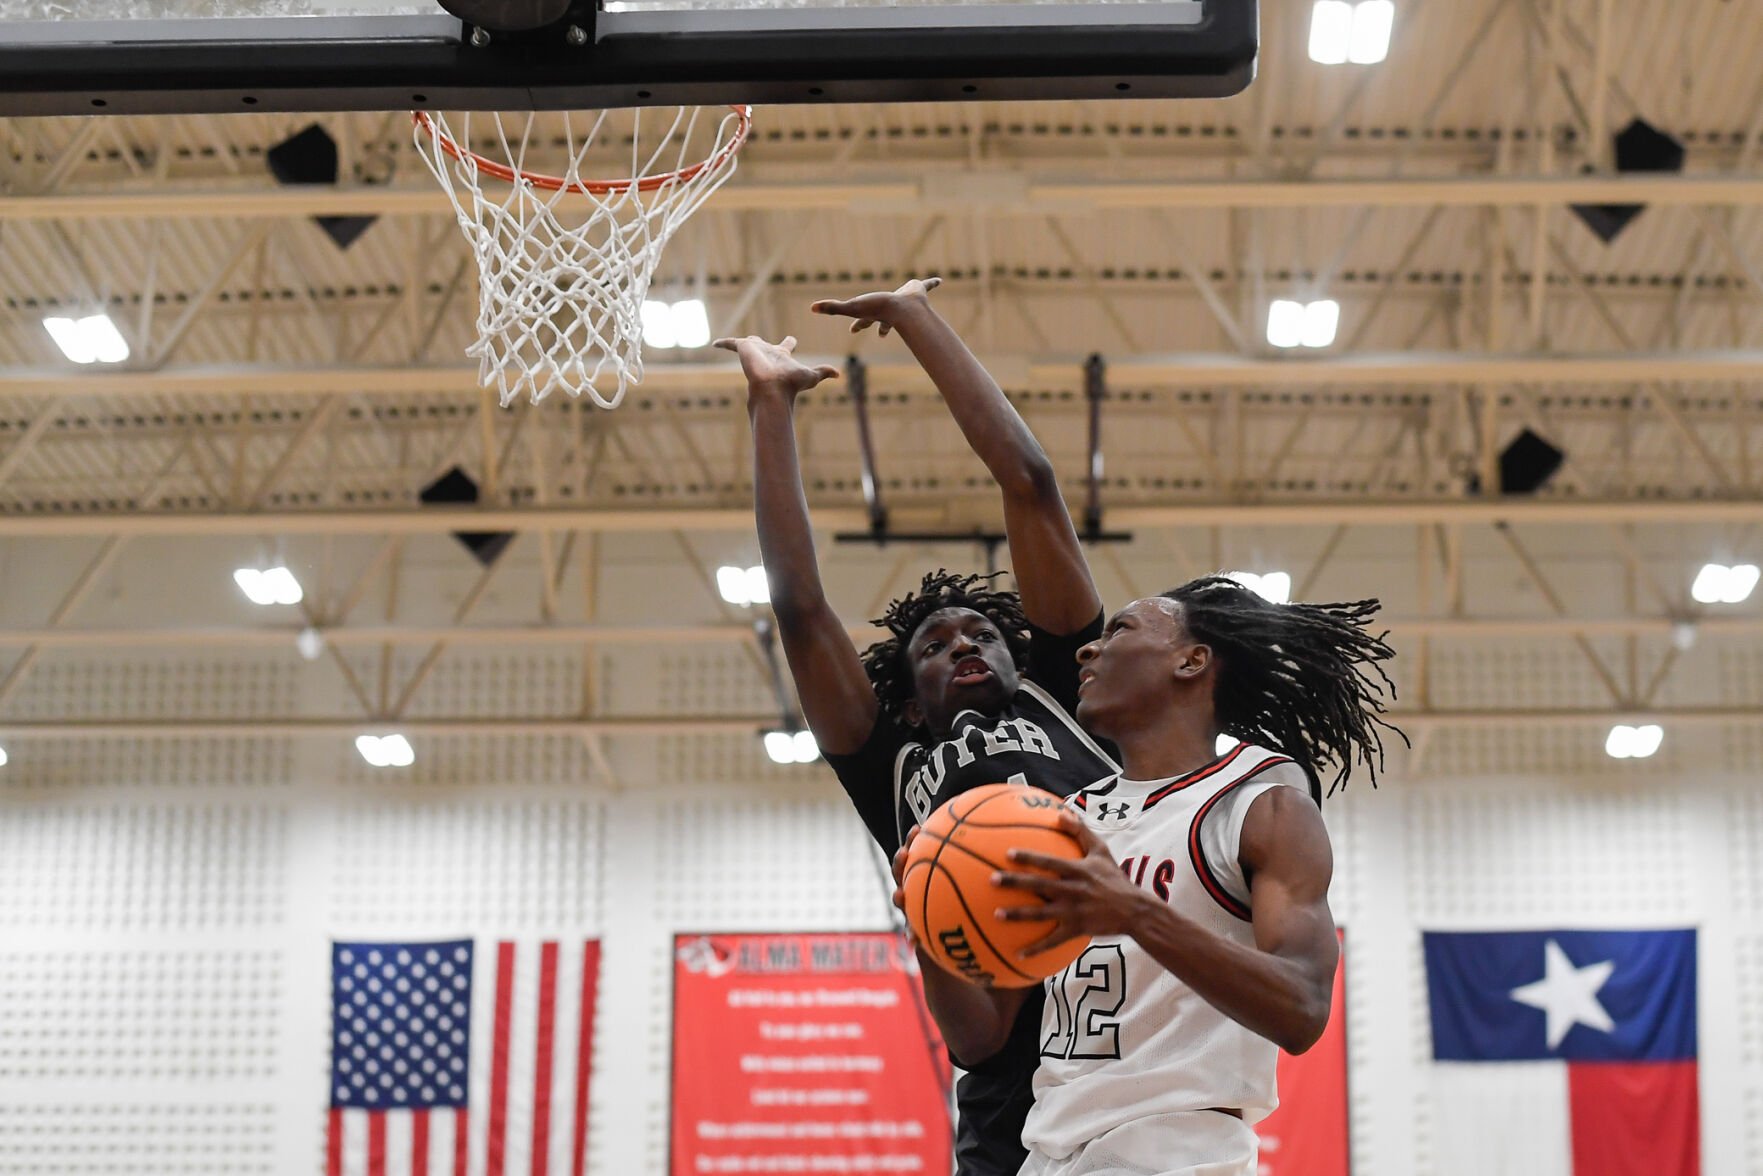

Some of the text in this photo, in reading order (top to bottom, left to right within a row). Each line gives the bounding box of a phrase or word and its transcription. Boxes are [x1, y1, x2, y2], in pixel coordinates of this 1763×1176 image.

[905, 717, 1061, 827] GUYER
[735, 940, 892, 973] ALMA MATER
[1040, 944, 1126, 1060] 12
